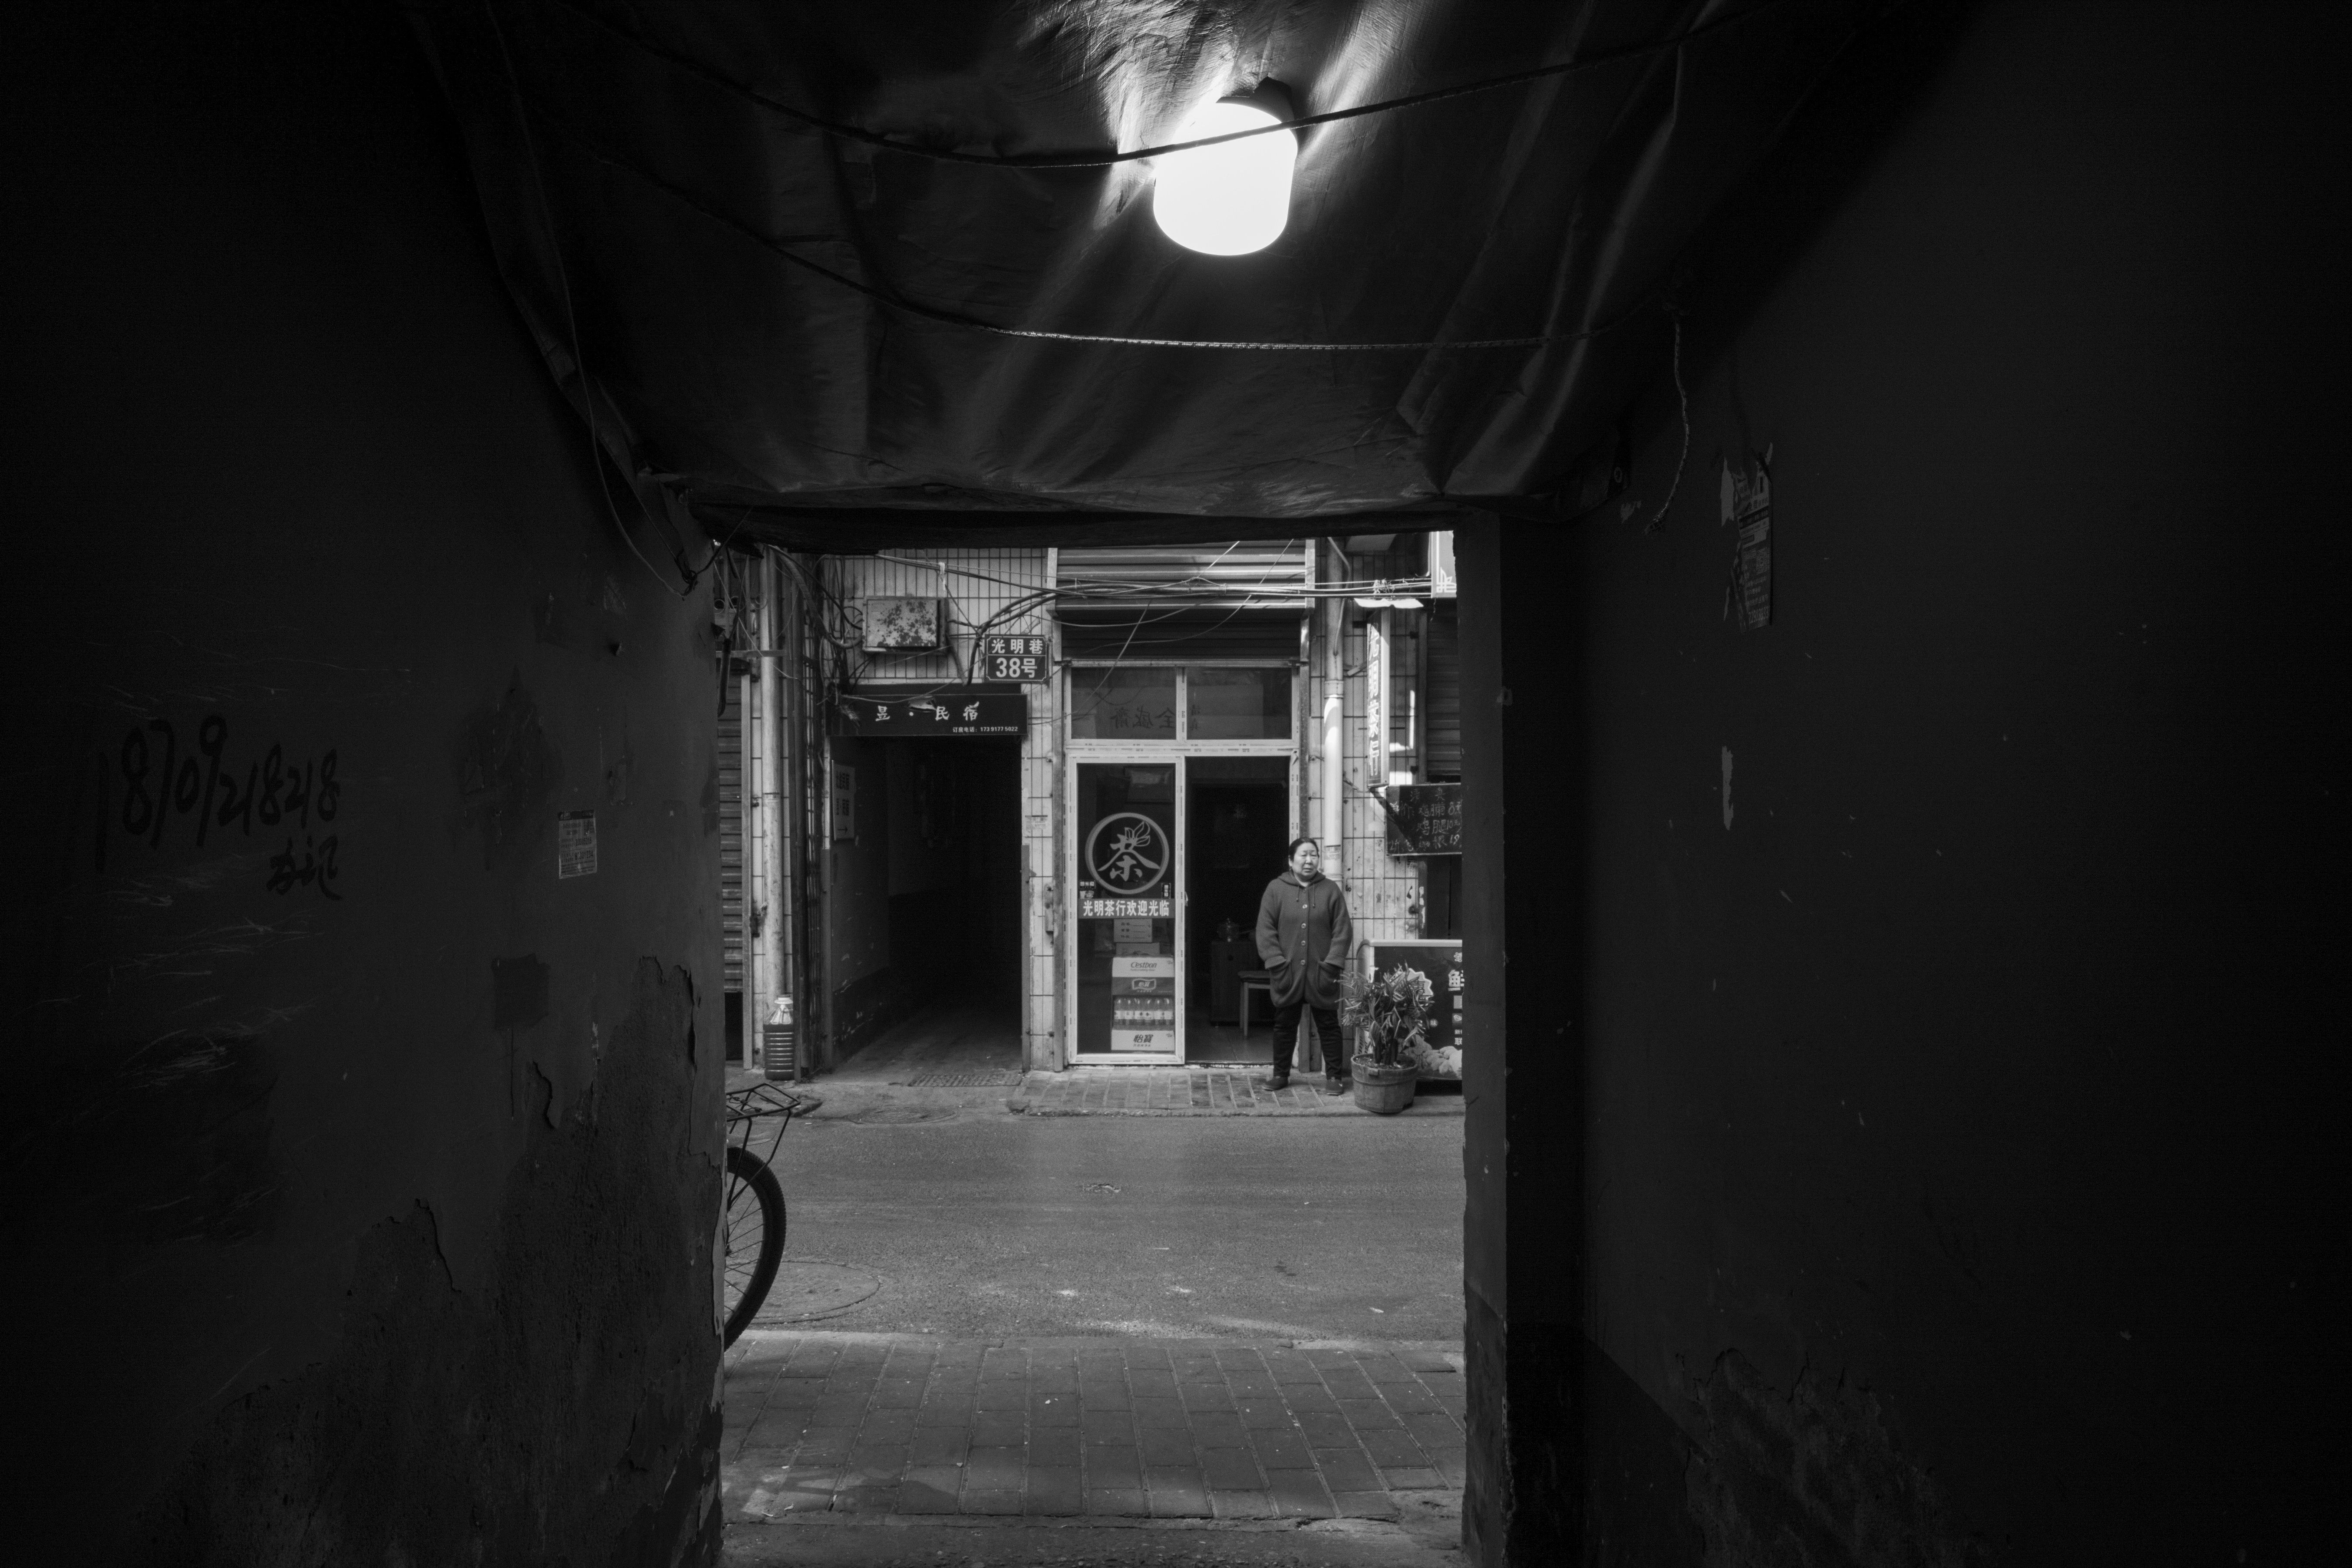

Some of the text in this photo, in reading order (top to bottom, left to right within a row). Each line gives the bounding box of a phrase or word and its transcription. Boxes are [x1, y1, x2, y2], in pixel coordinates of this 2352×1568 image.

[991, 638, 1043, 654] 光明巷
[996, 657, 1037, 678] 38号
[1083, 899, 1170, 917] 光明茶行欢迎光临
